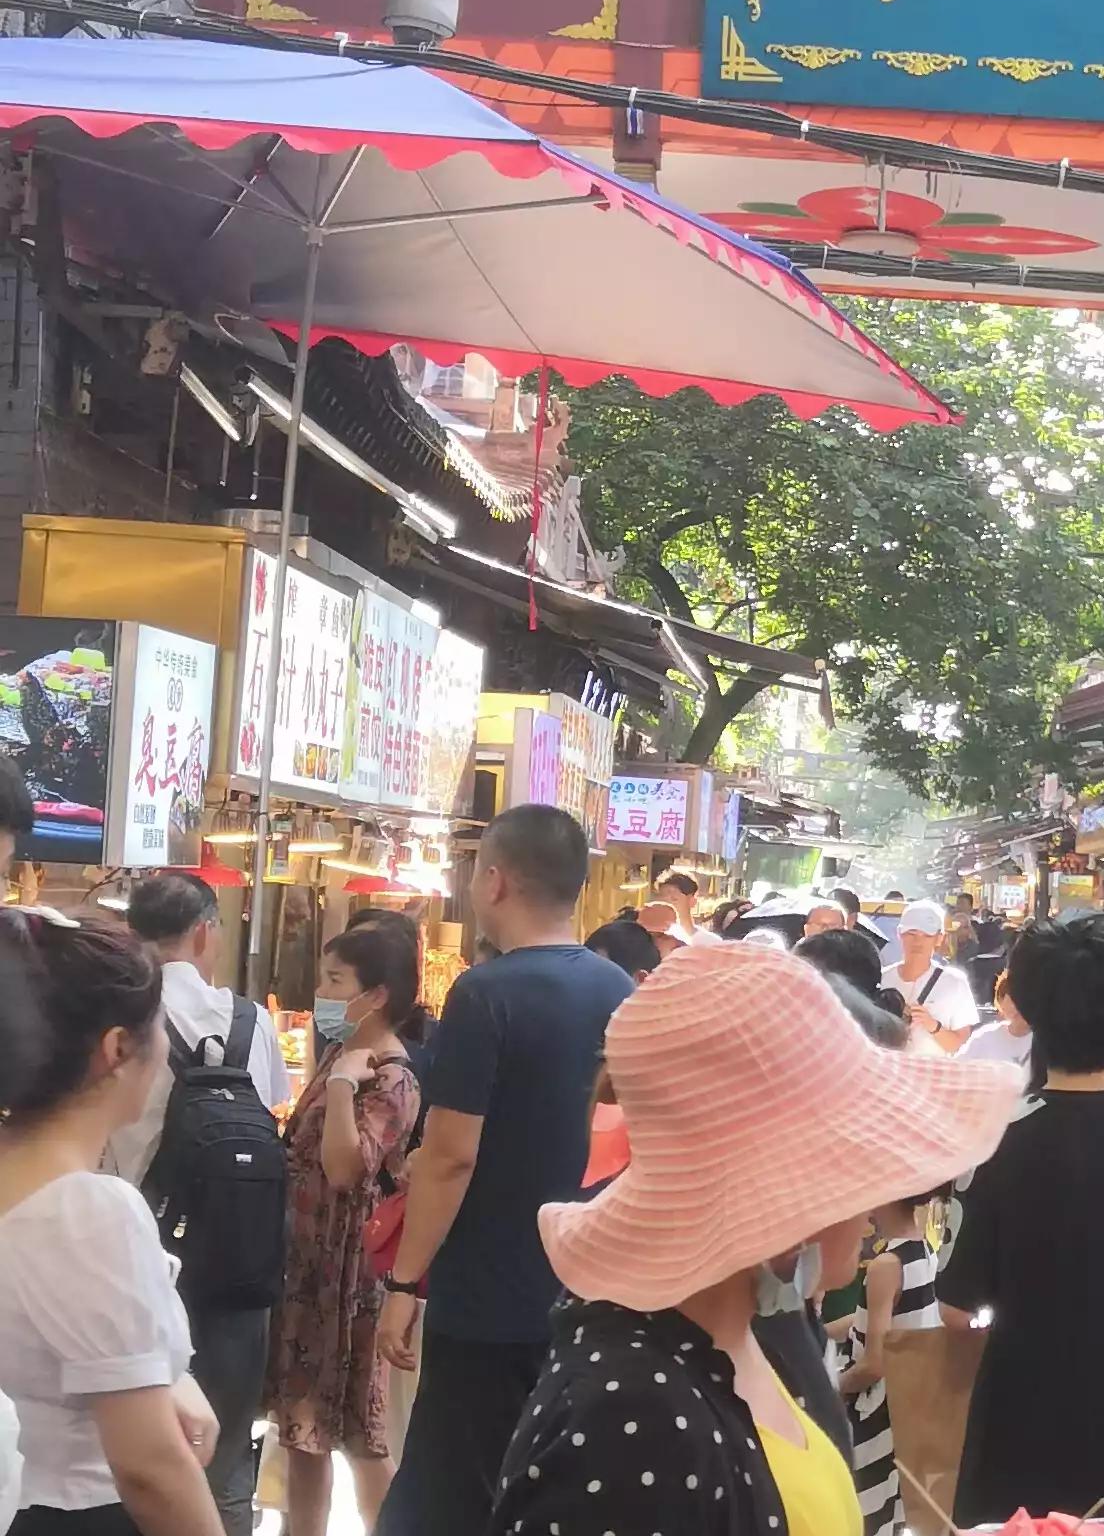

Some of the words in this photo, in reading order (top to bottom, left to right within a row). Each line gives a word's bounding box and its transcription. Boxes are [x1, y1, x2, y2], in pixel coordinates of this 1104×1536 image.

[248, 627, 297, 729] 石汁
[134, 707, 205, 802] 臭豆腐
